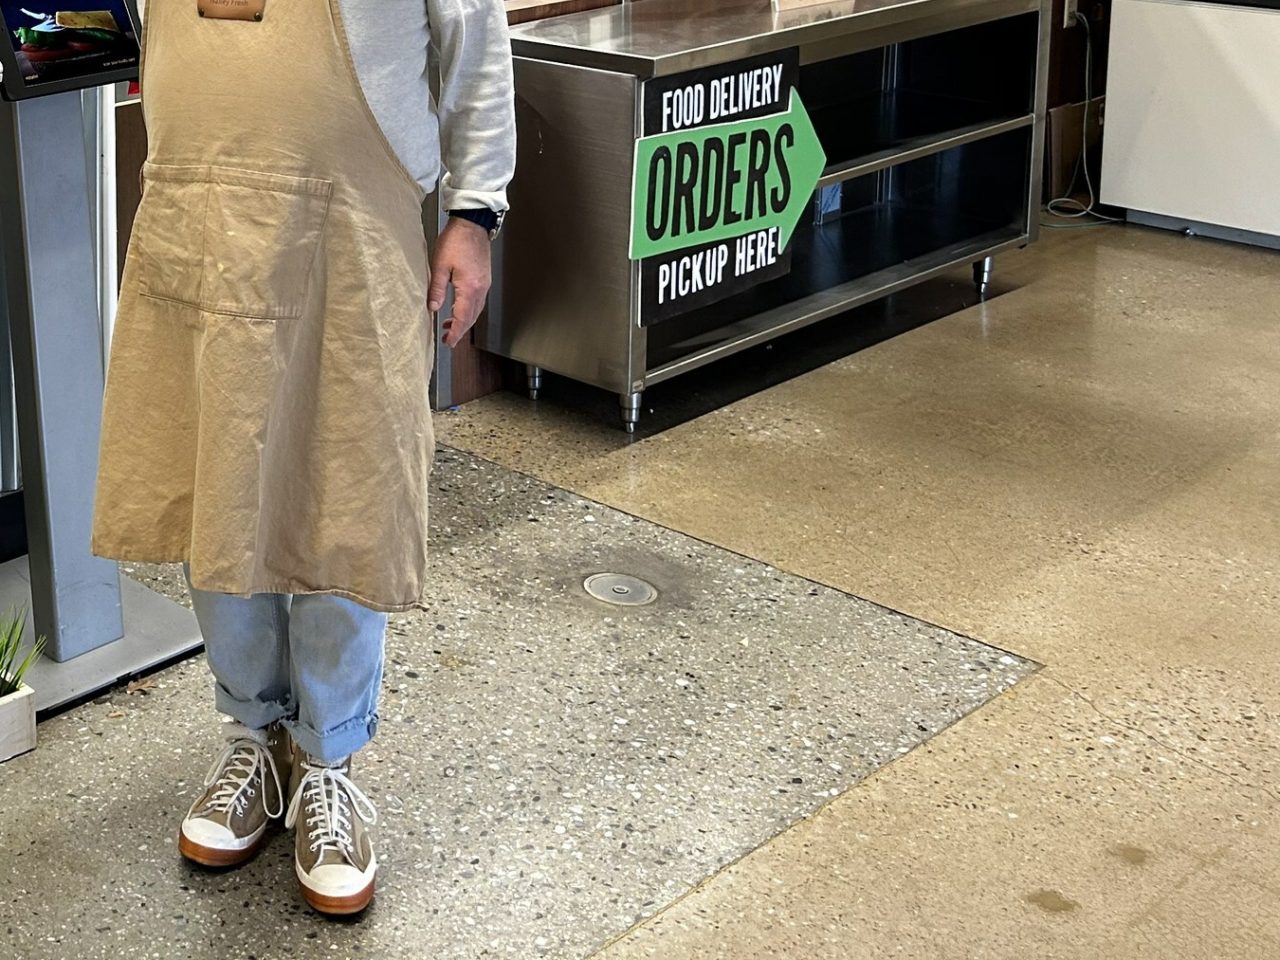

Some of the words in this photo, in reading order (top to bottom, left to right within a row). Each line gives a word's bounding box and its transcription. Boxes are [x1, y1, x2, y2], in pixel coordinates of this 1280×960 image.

[662, 83, 704, 133] FOOD
[709, 63, 784, 120] DELIVERY
[646, 123, 795, 241] ORDERS
[658, 243, 729, 305] PICKUP
[734, 226, 777, 277] HERE
